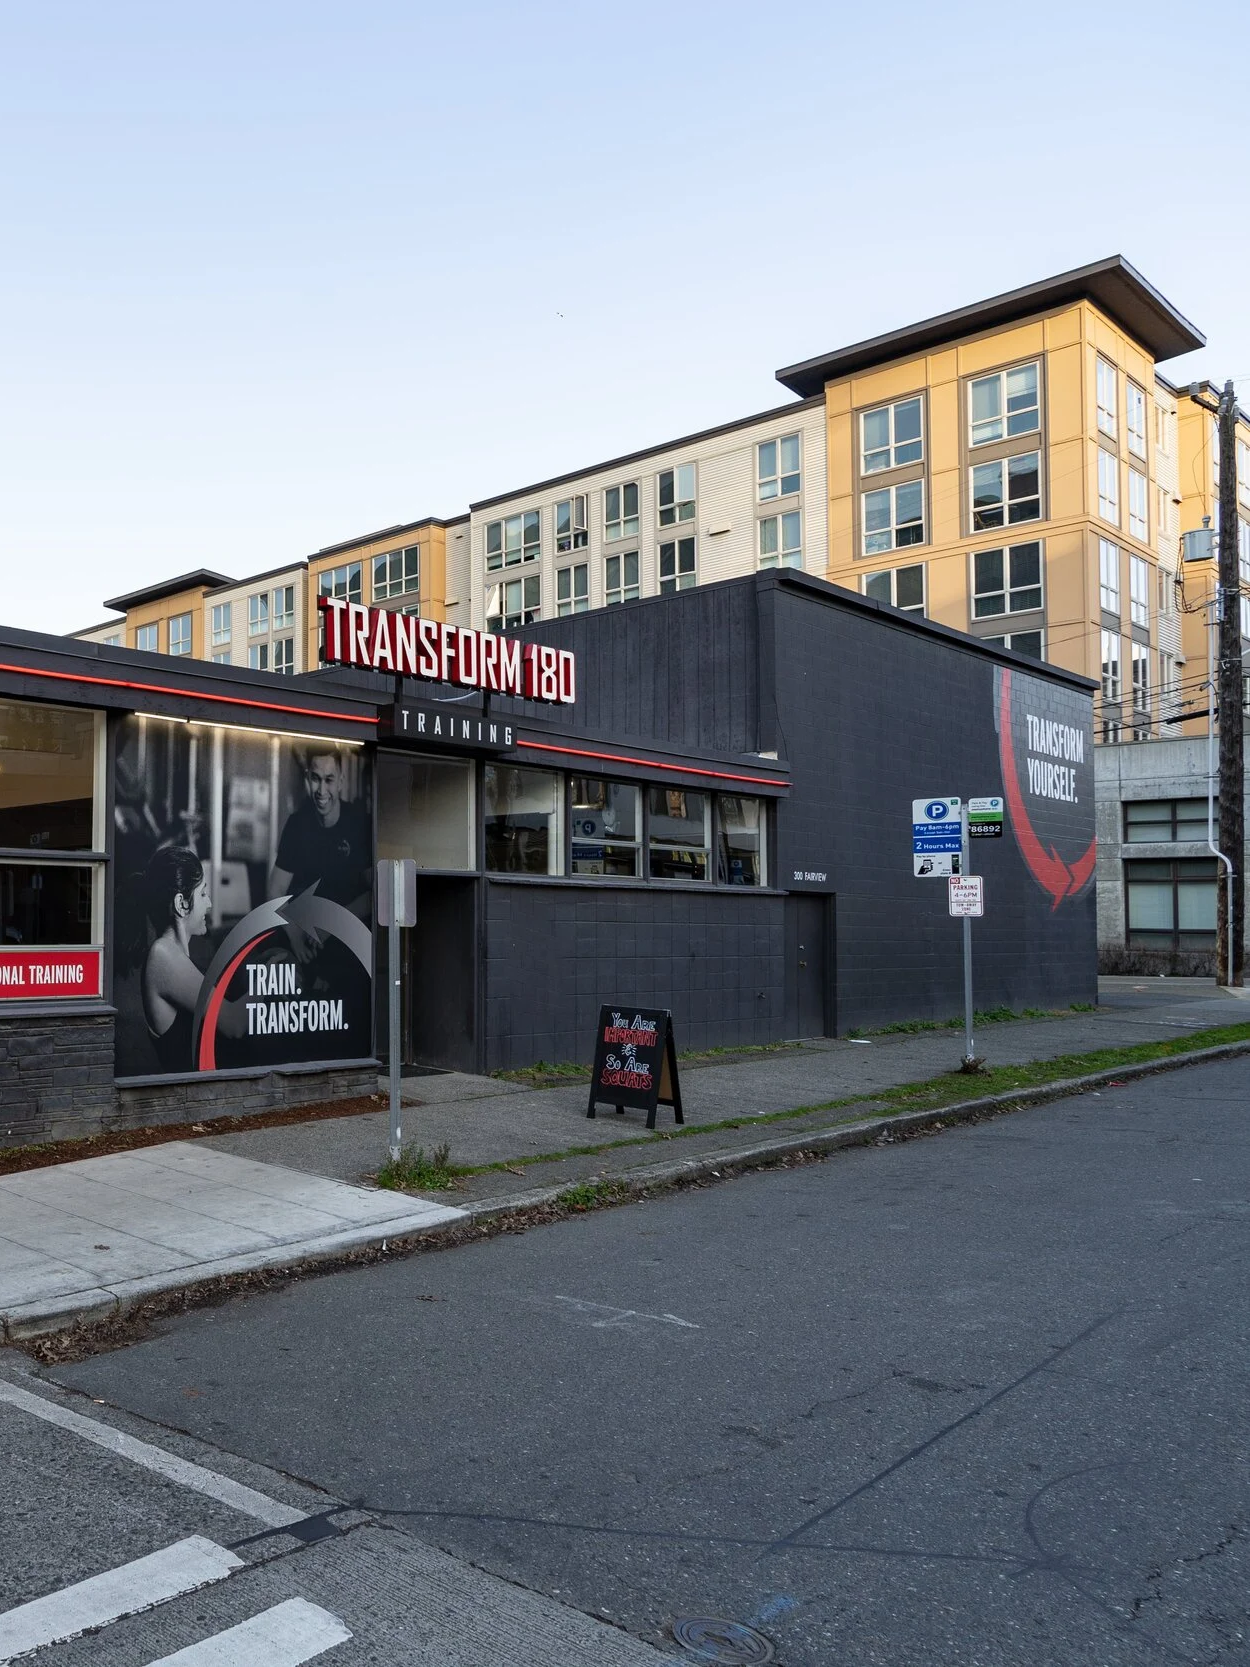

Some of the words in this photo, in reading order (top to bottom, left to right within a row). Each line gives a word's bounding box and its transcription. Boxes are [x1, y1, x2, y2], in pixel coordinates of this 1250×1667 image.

[327, 596, 521, 694] TRANSFORM
[528, 643, 576, 704] 180
[401, 710, 512, 746] TRAINING
[1026, 713, 1084, 764] TRANSFORM
[1026, 757, 1079, 804] YOURSELF.
[932, 805, 944, 817] P
[971, 825, 1001, 833] 86892
[916, 841, 922, 850] 2
[793, 871, 803, 880] 300
[28, 964, 84, 985] TRAINING
[246, 963, 302, 996] TRAIN.
[246, 999, 349, 1035] TRANSFORM.
[604, 1026, 659, 1047] IMPORTANT
[600, 1068, 653, 1090] SQUATS
